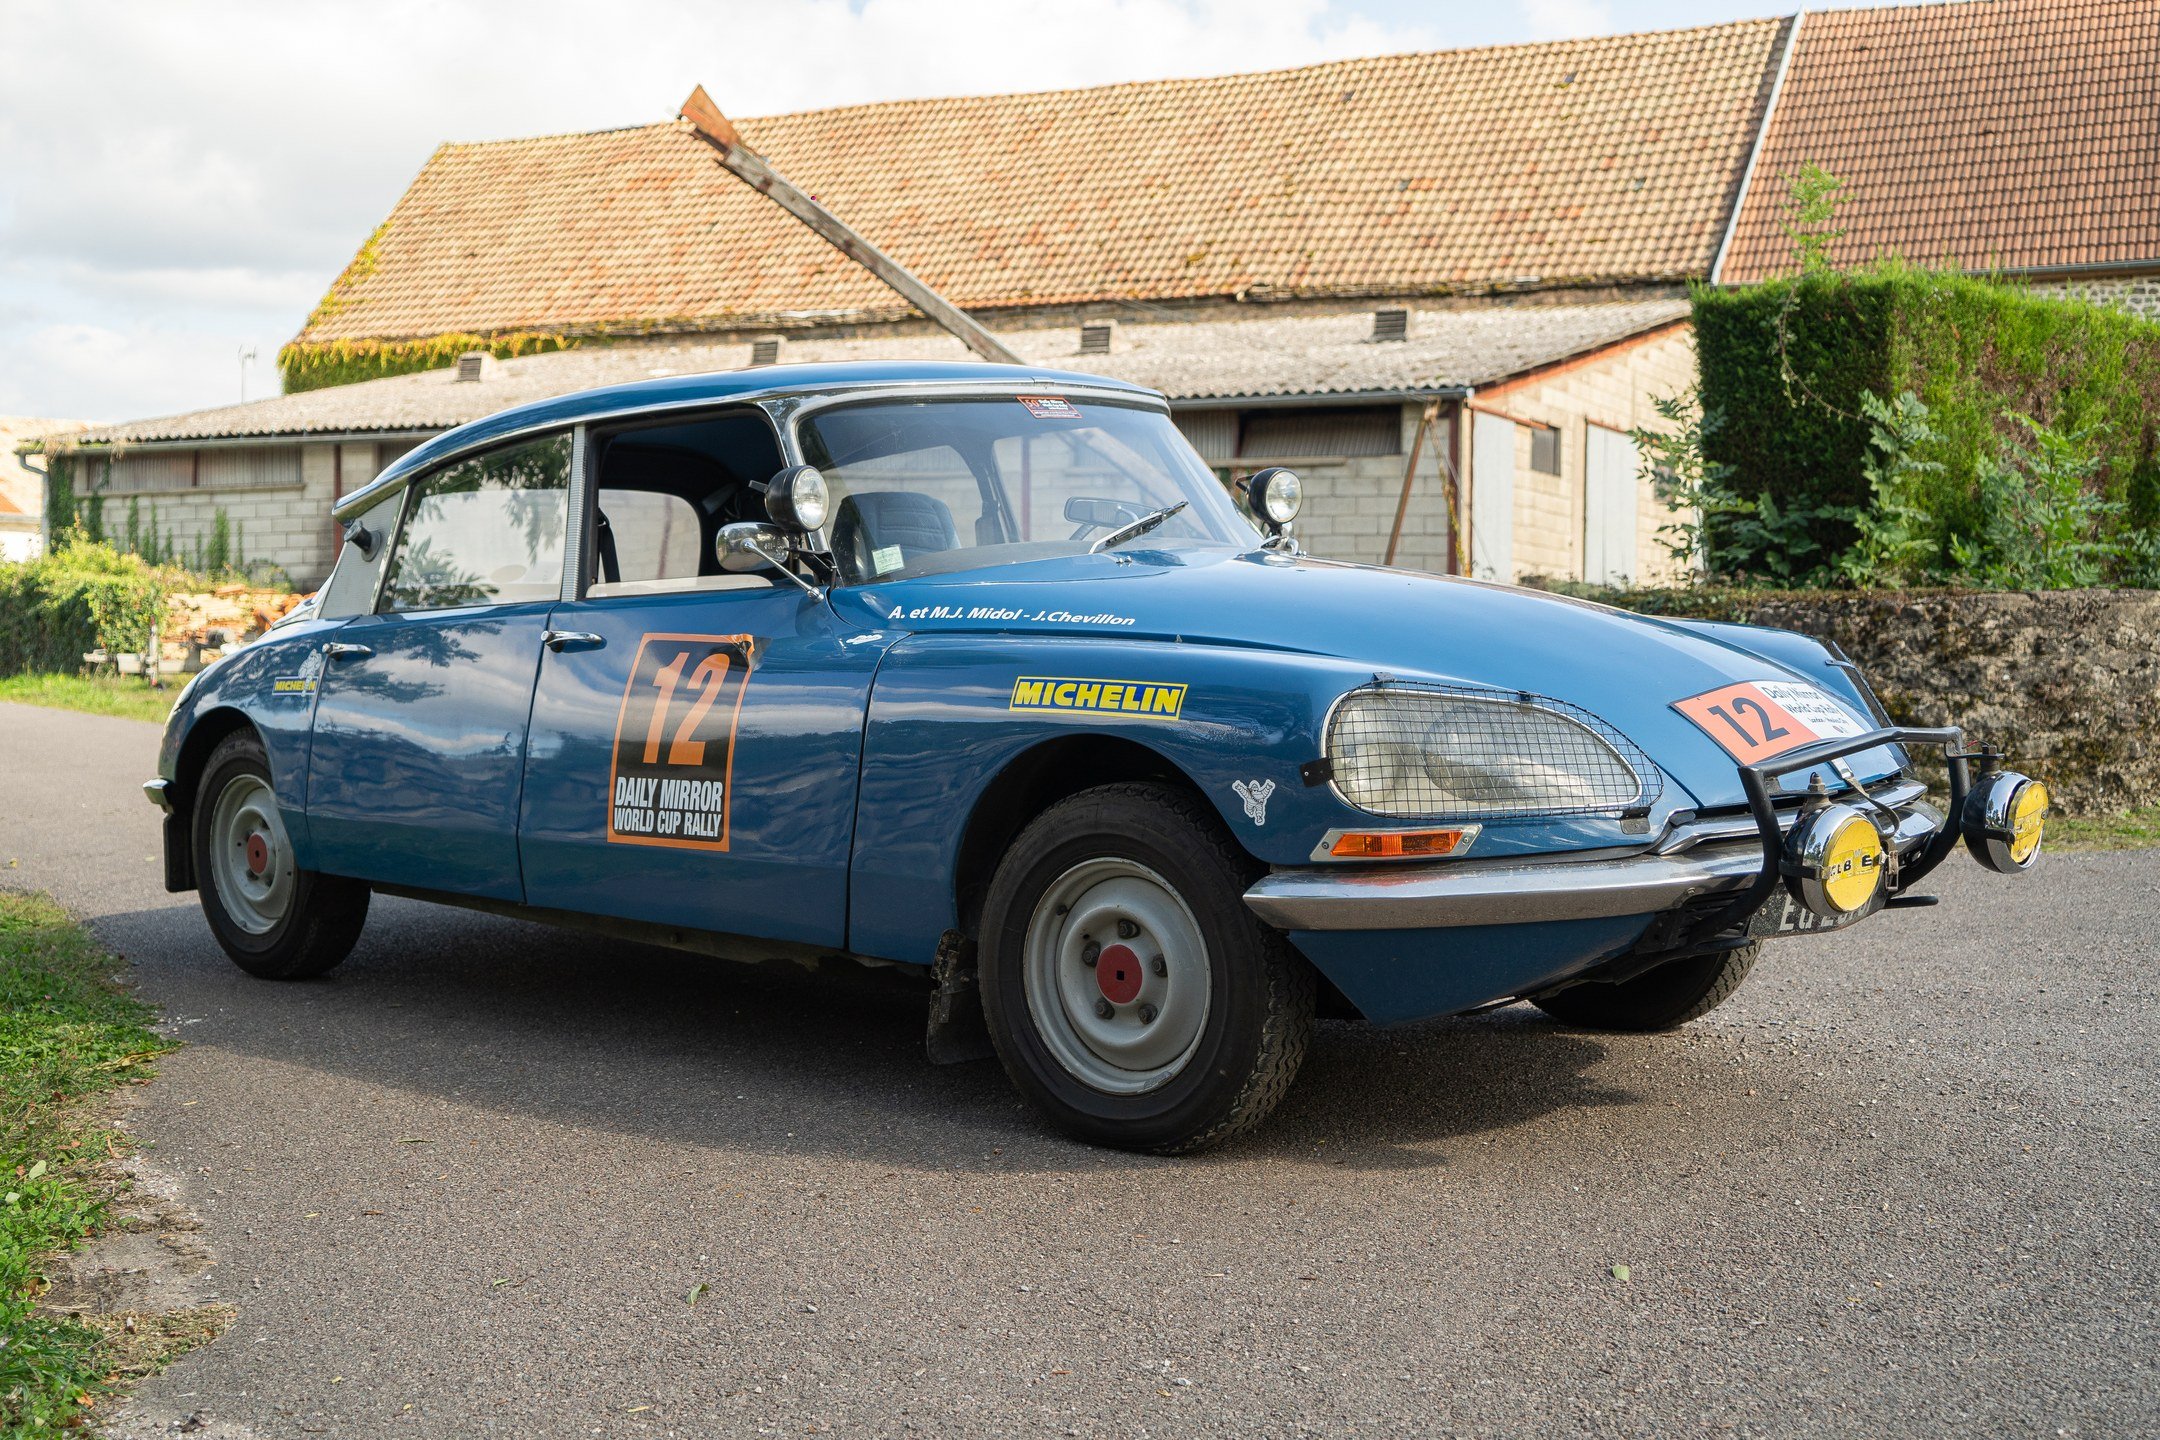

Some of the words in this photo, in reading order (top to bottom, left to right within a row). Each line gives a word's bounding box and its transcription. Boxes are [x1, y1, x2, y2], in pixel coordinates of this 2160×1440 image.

[888, 606, 906, 619] A.
[909, 606, 929, 619] et
[929, 606, 964, 619] M.J.
[967, 607, 1024, 620] Midol
[1031, 610, 1136, 626] J.Chevillon
[274, 680, 316, 691] MICHELN
[1014, 681, 1181, 713] MICHELIN
[642, 652, 730, 766] 12
[1707, 697, 1790, 748] 12
[615, 776, 658, 808] DAILY
[659, 779, 723, 812] MIRROR
[614, 808, 655, 833] WORLD
[657, 810, 682, 834] CUP
[684, 812, 722, 837] RALLY
